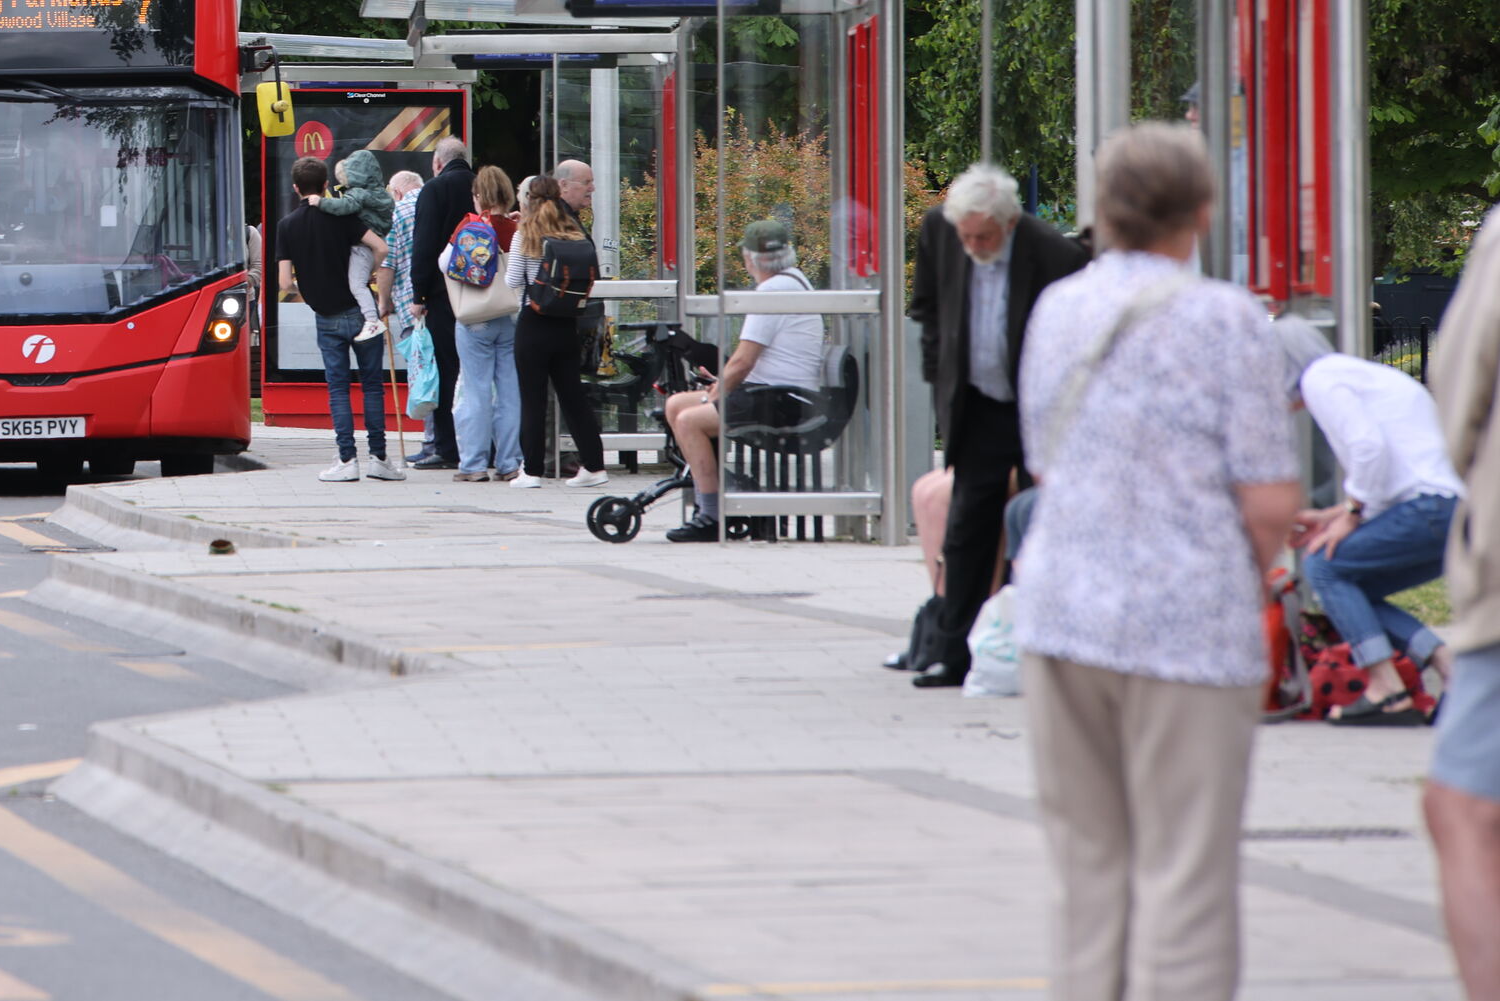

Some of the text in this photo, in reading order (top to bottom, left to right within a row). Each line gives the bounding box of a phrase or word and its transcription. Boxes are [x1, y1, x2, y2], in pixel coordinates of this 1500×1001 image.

[47, 10, 96, 29] Village
[1, 419, 79, 437] SK65 PVY
